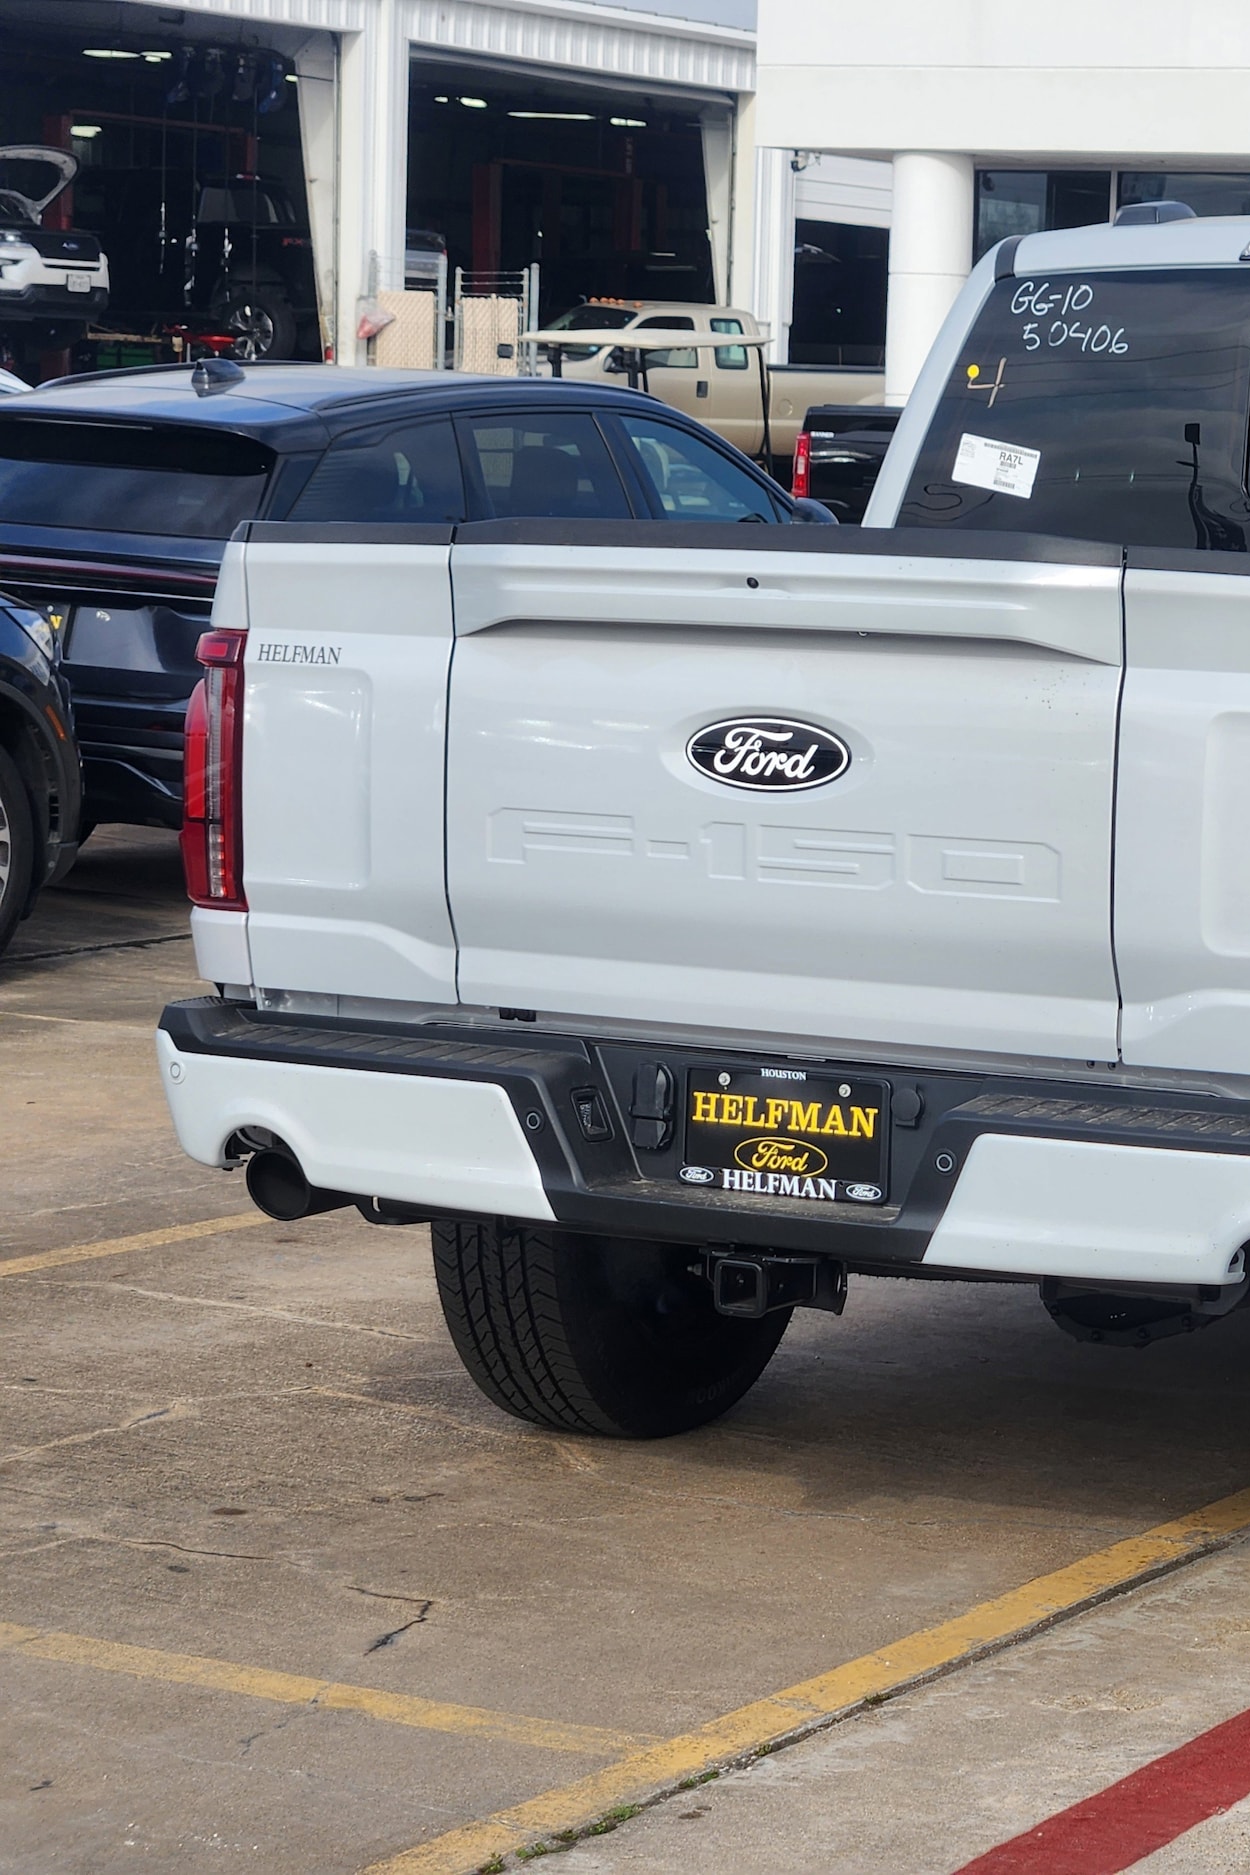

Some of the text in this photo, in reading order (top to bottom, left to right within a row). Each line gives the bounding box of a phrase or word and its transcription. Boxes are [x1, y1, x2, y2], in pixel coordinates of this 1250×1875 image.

[999, 451, 1023, 465] RA7L
[257, 643, 342, 664] HELFMAN
[487, 807, 1062, 903] F-150
[760, 1067, 807, 1081] HOUSTON
[692, 1091, 879, 1138] HELFMAN
[752, 1140, 810, 1172] Ford
[721, 1168, 837, 1200] HELFMAN
